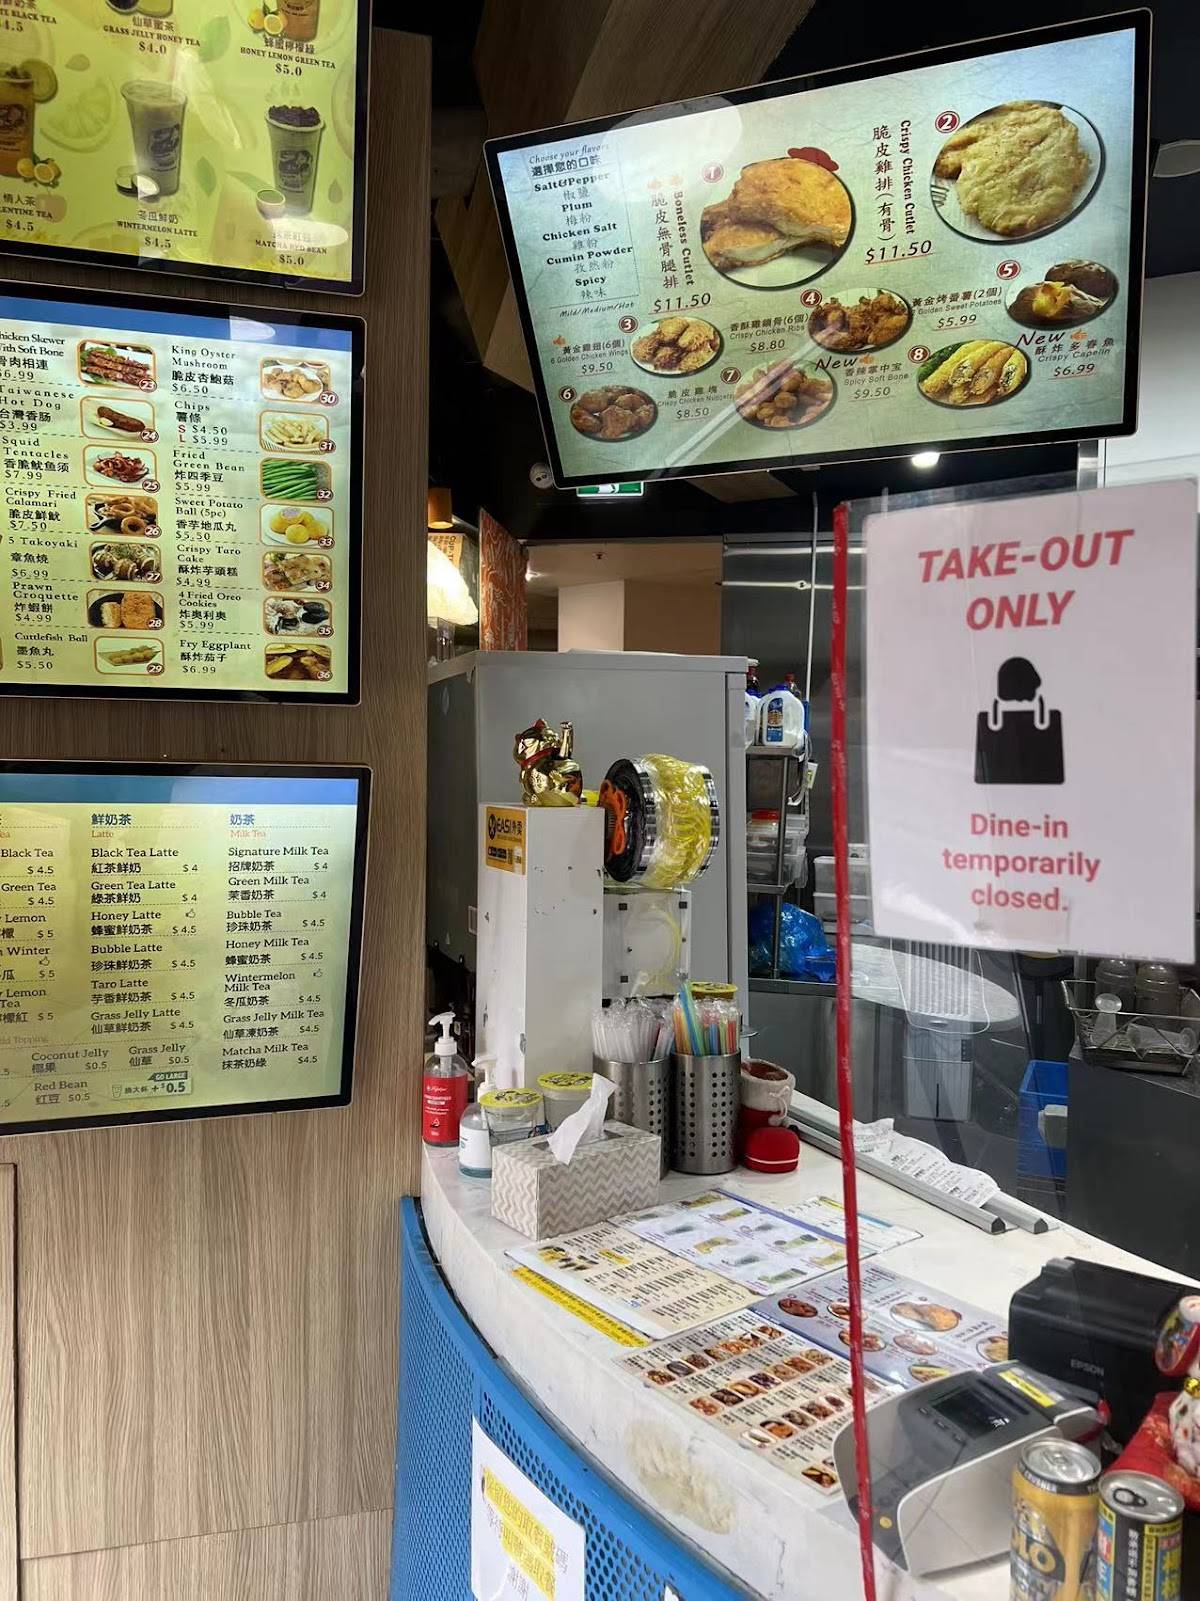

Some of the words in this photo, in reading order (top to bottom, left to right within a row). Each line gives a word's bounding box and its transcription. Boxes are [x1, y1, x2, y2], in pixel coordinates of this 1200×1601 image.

[12, 11, 38, 21] BLACK
[40, 15, 57, 24] TEA
[103, 25, 129, 35] GRASS
[131, 29, 155, 39] JELLY
[156, 33, 183, 44] HONEY
[186, 38, 201, 47] TEA
[240, 46, 266, 57] HONEY
[268, 51, 293, 61] LEMON
[295, 55, 320, 66] GREEN
[321, 60, 336, 69] TEA
[275, 63, 302, 76] $5.0
[900, 119, 912, 160] Crispy
[529, 151, 559, 165] Choose
[559, 147, 580, 161] your
[534, 171, 610, 192] Salt&Pepper
[900, 157, 914, 202] Chicken
[561, 201, 593, 213] Plum
[36, 210, 53, 220] TEA
[903, 201, 917, 235] Cutlet
[6, 219, 34, 232] $4.5
[116, 220, 172, 234] WINTERMELON
[174, 227, 198, 237] LATTE
[542, 226, 591, 242] Chicken
[593, 222, 617, 235] Salt
[144, 236, 171, 249] $4.5
[673, 191, 688, 245] Boneless
[681, 249, 695, 286] Cutlet
[546, 254, 584, 266] Cumin
[588, 245, 633, 260] Powder
[865, 240, 933, 264] $11.50
[278, 254, 304, 265] $5.0
[575, 275, 607, 288] Spicy
[653, 292, 711, 313] $11.50
[969, 299, 1001, 309] Potatoes
[937, 314, 977, 329] $5.99
[729, 329, 754, 340] Crispy
[755, 326, 786, 336] Chicken
[1016, 330, 1066, 349] New
[172, 345, 196, 356] King
[201, 347, 236, 359] Oyster
[750, 339, 785, 353] $8.80
[1038, 352, 1068, 363] Crispy
[1072, 347, 1111, 358] Capelin
[172, 357, 228, 370] Mushroom
[582, 361, 613, 375] $9.50
[815, 355, 858, 371] New
[1053, 363, 1096, 378] $6.99
[868, 374, 885, 383] Soft
[172, 383, 208, 394] $6.50
[853, 386, 891, 400] $9.50
[320, 394, 335, 404] 30
[174, 400, 210, 412] Chips
[676, 407, 709, 420] $8.50
[192, 425, 228, 435] $4.50
[2, 436, 40, 447] Squid
[320, 442, 334, 451] 31
[3, 447, 69, 459] Tentacles
[173, 450, 205, 459] Fried
[173, 460, 210, 469] Green
[216, 463, 245, 472] Bean
[5, 469, 42, 480] $7.99
[143, 482, 158, 490] 25
[175, 482, 211, 492] $5.99
[5, 487, 40, 498] Crispy
[48, 490, 76, 499] Fried
[318, 490, 332, 499] 32
[6, 497, 57, 508] Calamari
[175, 497, 204, 507] Sweet
[209, 499, 243, 509] Potato
[19, 537, 78, 549] Takoyaki
[177, 544, 210, 555] Crispy
[918, 528, 1135, 583] TAKE-OUT
[12, 568, 49, 579] $6.99
[147, 572, 161, 581] 27
[13, 582, 53, 591] Prawn
[13, 590, 79, 602] Croquette
[179, 591, 184, 599] 4
[179, 599, 217, 608] Cookies
[966, 590, 1075, 630] ONLY
[14, 632, 63, 642] Cuttlefish
[68, 634, 88, 642] Ball
[202, 640, 251, 651] Eggplant
[970, 813, 1069, 839] Dine-in
[91, 848, 123, 858] Black
[126, 848, 146, 857] Tea
[150, 848, 179, 857] Latte
[228, 847, 280, 857] Signature
[283, 846, 308, 856] Milk
[310, 846, 329, 855] Tea
[942, 849, 1101, 883] temporarily
[91, 882, 124, 891] Green
[127, 881, 146, 890] Tea
[148, 881, 176, 889] Latte
[228, 877, 261, 886] Green
[263, 876, 288, 885] Milk
[291, 876, 310, 885] Tea
[971, 883, 1069, 912] closed.
[91, 912, 129, 922] Honey
[132, 911, 162, 920] Latte
[226, 910, 262, 919] Bubble
[264, 909, 282, 918] Tea
[91, 945, 131, 954] Bubble
[133, 944, 163, 953] Latte
[226, 940, 261, 949] Honey
[264, 938, 288, 947] Milk
[291, 937, 310, 946] Tea
[225, 971, 296, 982] Wintermelon
[91, 980, 117, 989] Taro
[120, 979, 149, 988] Latte
[224, 983, 249, 993] Milk
[252, 982, 271, 991] Tea
[224, 995, 269, 1007] 冬瓜奶茶
[91, 1012, 121, 1021] Grass
[123, 1010, 149, 1020] Jelly
[152, 1008, 181, 1017] Latte
[223, 1014, 251, 1023] Grass
[253, 1012, 278, 1022] Jelly
[280, 1010, 304, 1020] Milk
[307, 1009, 325, 1018] Tea
[31, 1052, 79, 1061] Coconut
[81, 1048, 109, 1058] Jelly
[129, 1046, 157, 1055] Grass
[160, 1043, 186, 1053] Jelly
[222, 1046, 261, 1056] Matcha
[264, 1044, 288, 1053] Milk
[291, 1043, 309, 1052] Tea
[34, 1082, 56, 1091] Red
[59, 1080, 88, 1090] Bean
[1070, 1358, 1105, 1376] EPSON
